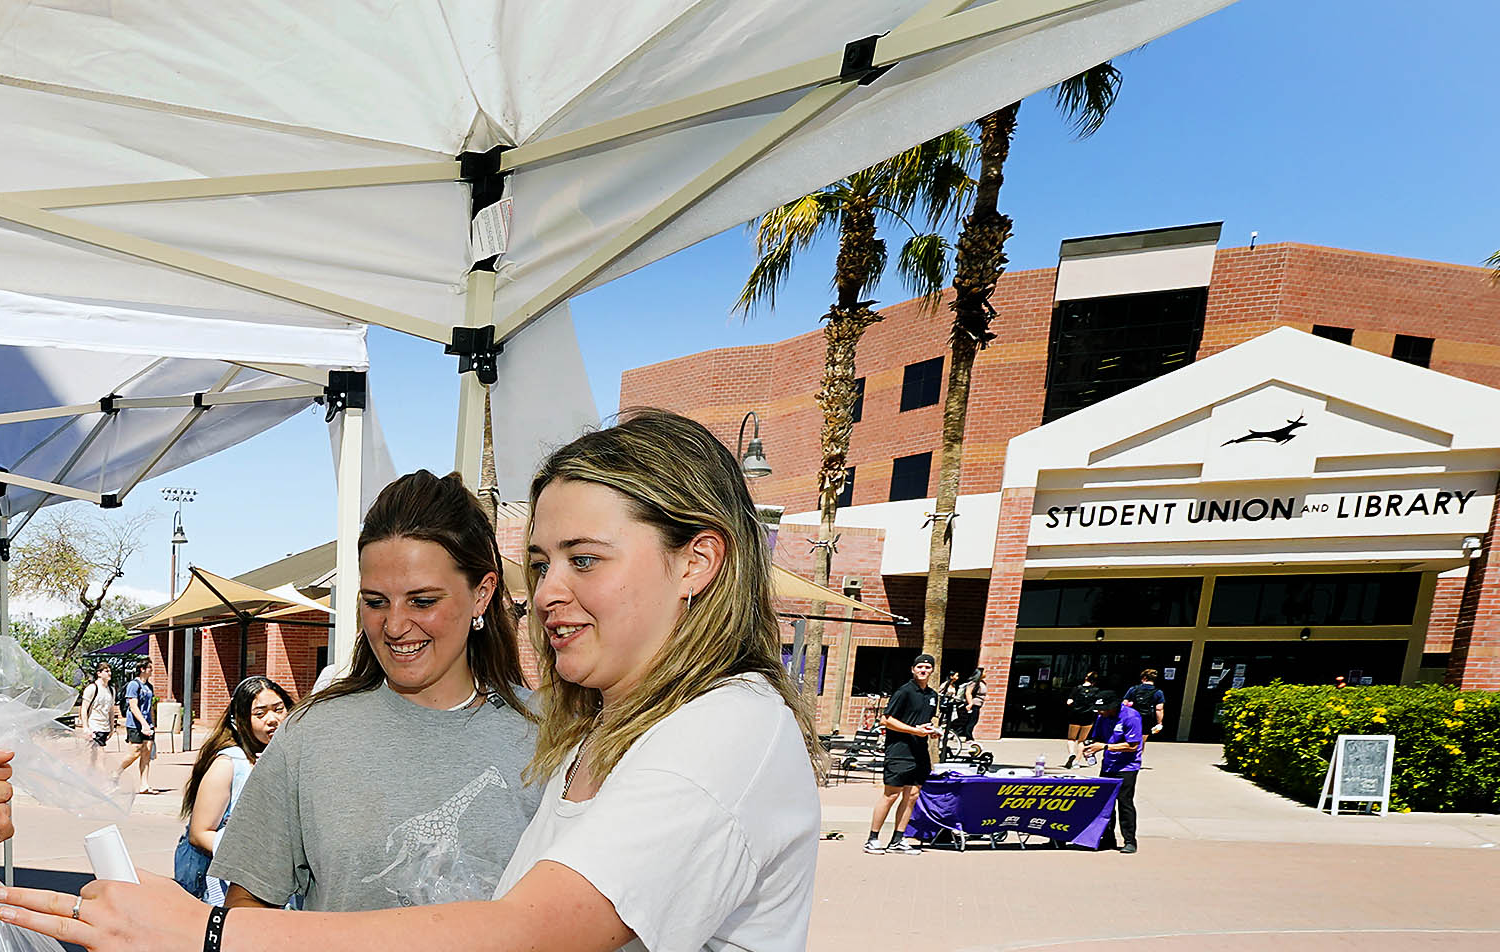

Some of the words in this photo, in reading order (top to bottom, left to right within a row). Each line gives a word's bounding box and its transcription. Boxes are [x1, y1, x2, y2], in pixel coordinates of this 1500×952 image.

[1045, 502, 1177, 528] STUDENT
[1187, 497, 1295, 523] UNION
[1301, 503, 1329, 513] AND
[1337, 490, 1476, 518] LIBRARY
[997, 784, 1051, 796] WE'RE
[1050, 785, 1100, 797] HERE
[999, 797, 1037, 809] FOR
[1036, 799, 1076, 811] YOU
